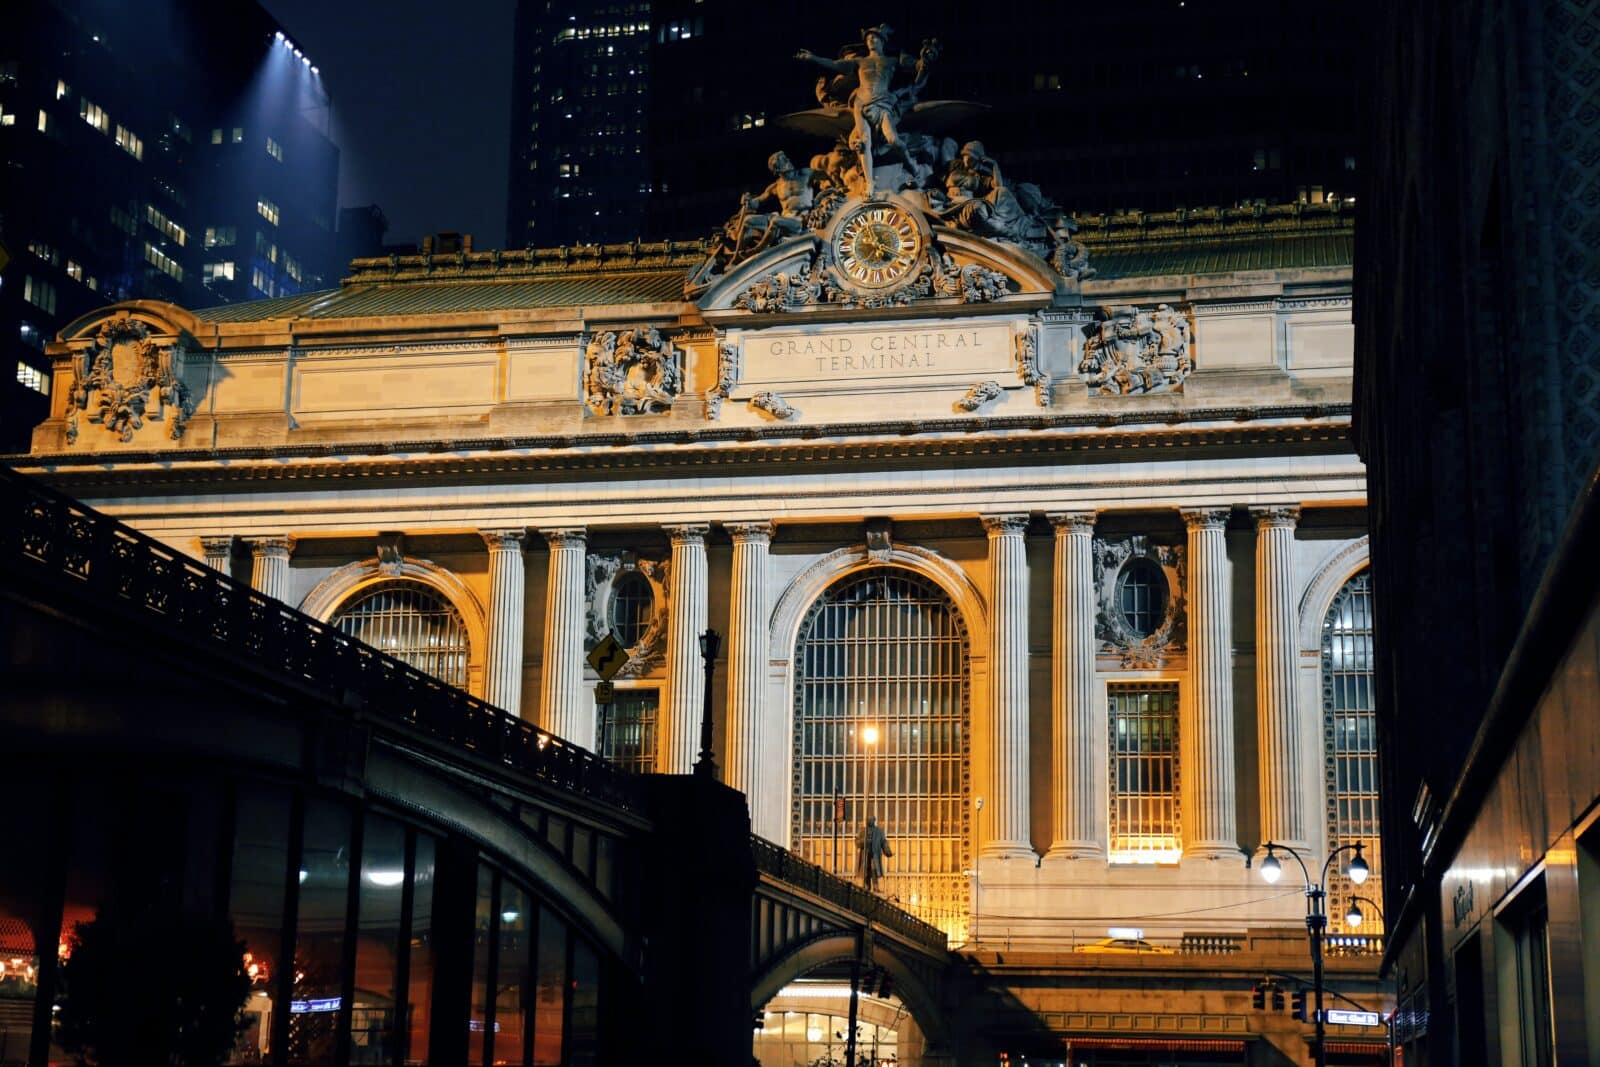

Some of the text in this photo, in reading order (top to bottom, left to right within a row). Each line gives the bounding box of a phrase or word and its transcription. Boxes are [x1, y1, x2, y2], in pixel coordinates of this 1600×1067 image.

[769, 332, 983, 356] GRAND CENTRAL
[815, 352, 937, 372] TERMINAL
